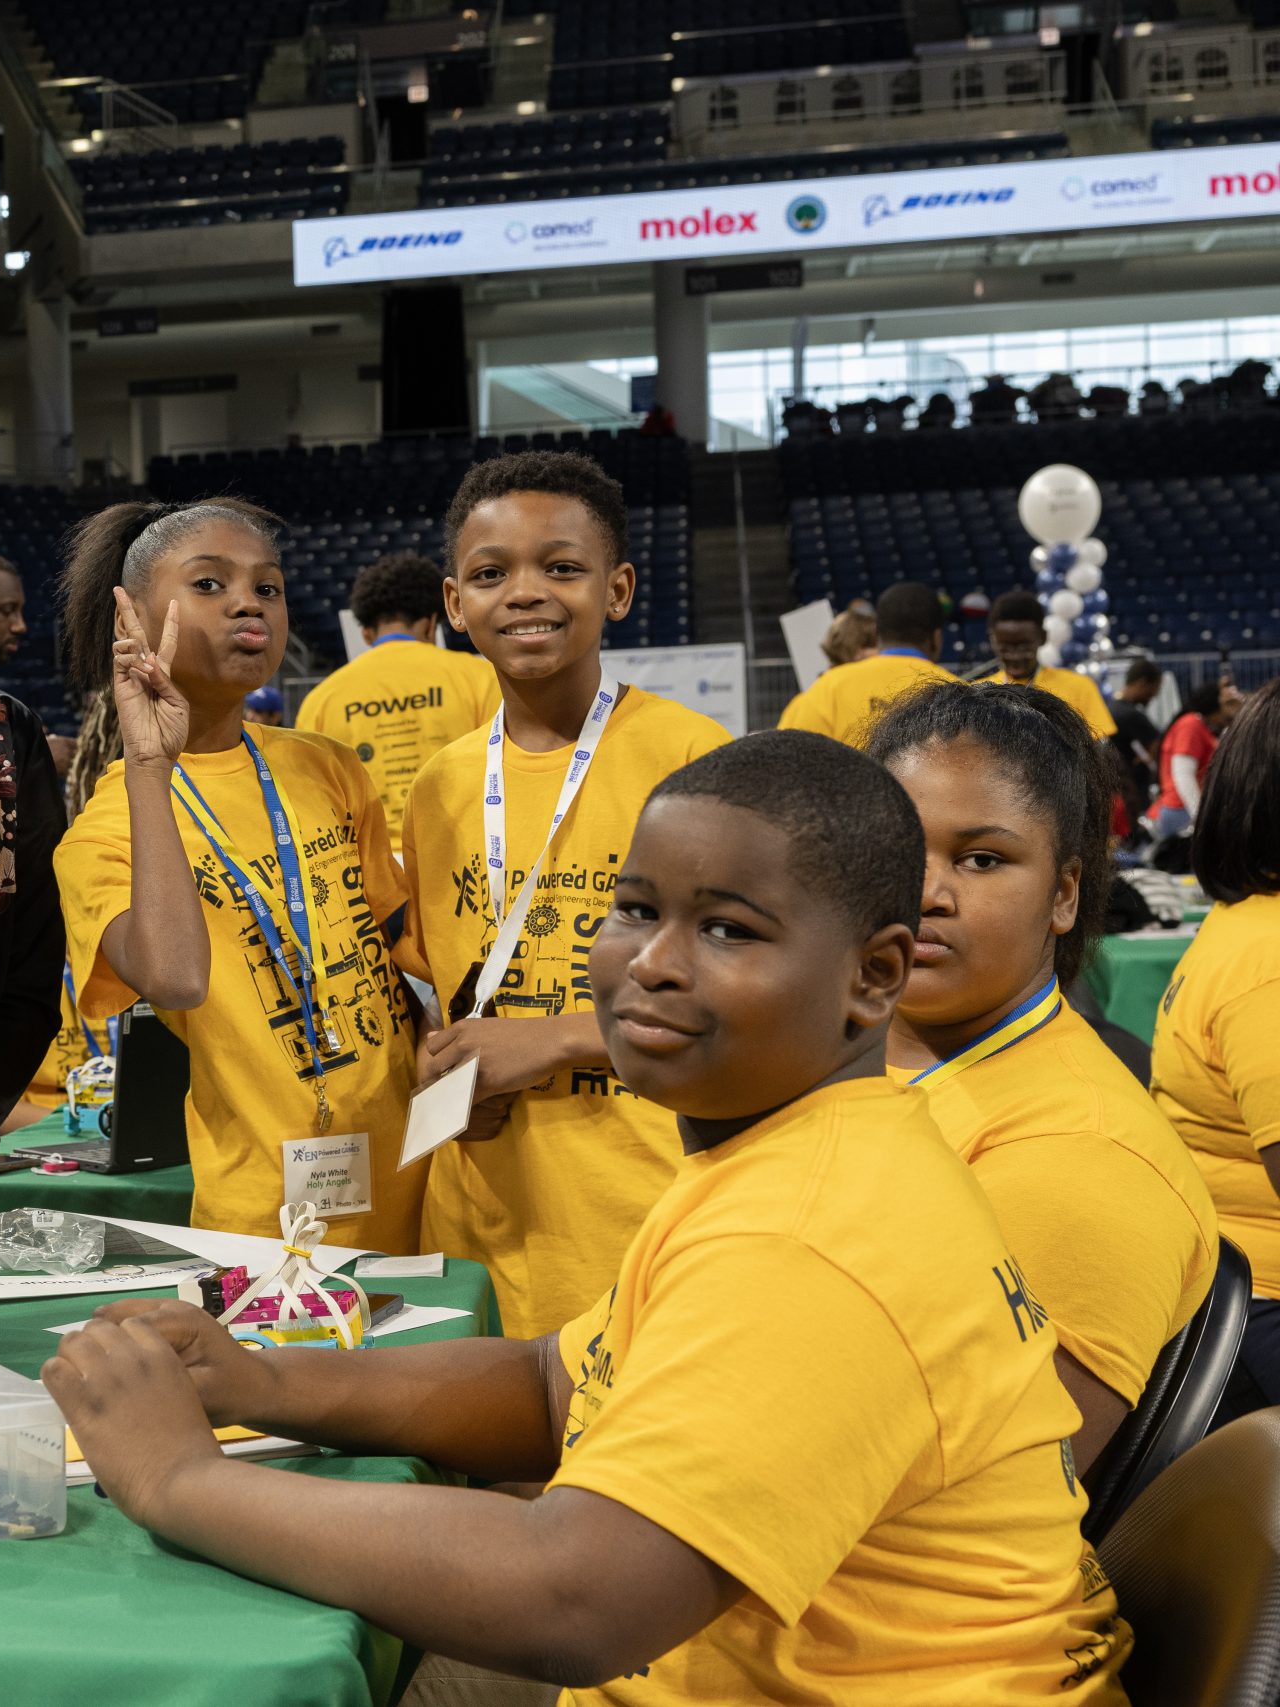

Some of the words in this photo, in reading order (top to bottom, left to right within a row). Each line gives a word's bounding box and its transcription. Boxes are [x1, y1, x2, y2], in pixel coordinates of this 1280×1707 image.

[359, 230, 464, 253] BOEING
[639, 207, 758, 241] molex
[901, 186, 1016, 211] BOEING
[345, 686, 442, 722] Powell
[510, 868, 587, 891] Pwered
[306, 1180, 324, 1190] Holy
[325, 1177, 352, 1188] Angels
[310, 1171, 327, 1180] Nyla
[327, 1168, 349, 1178] White
